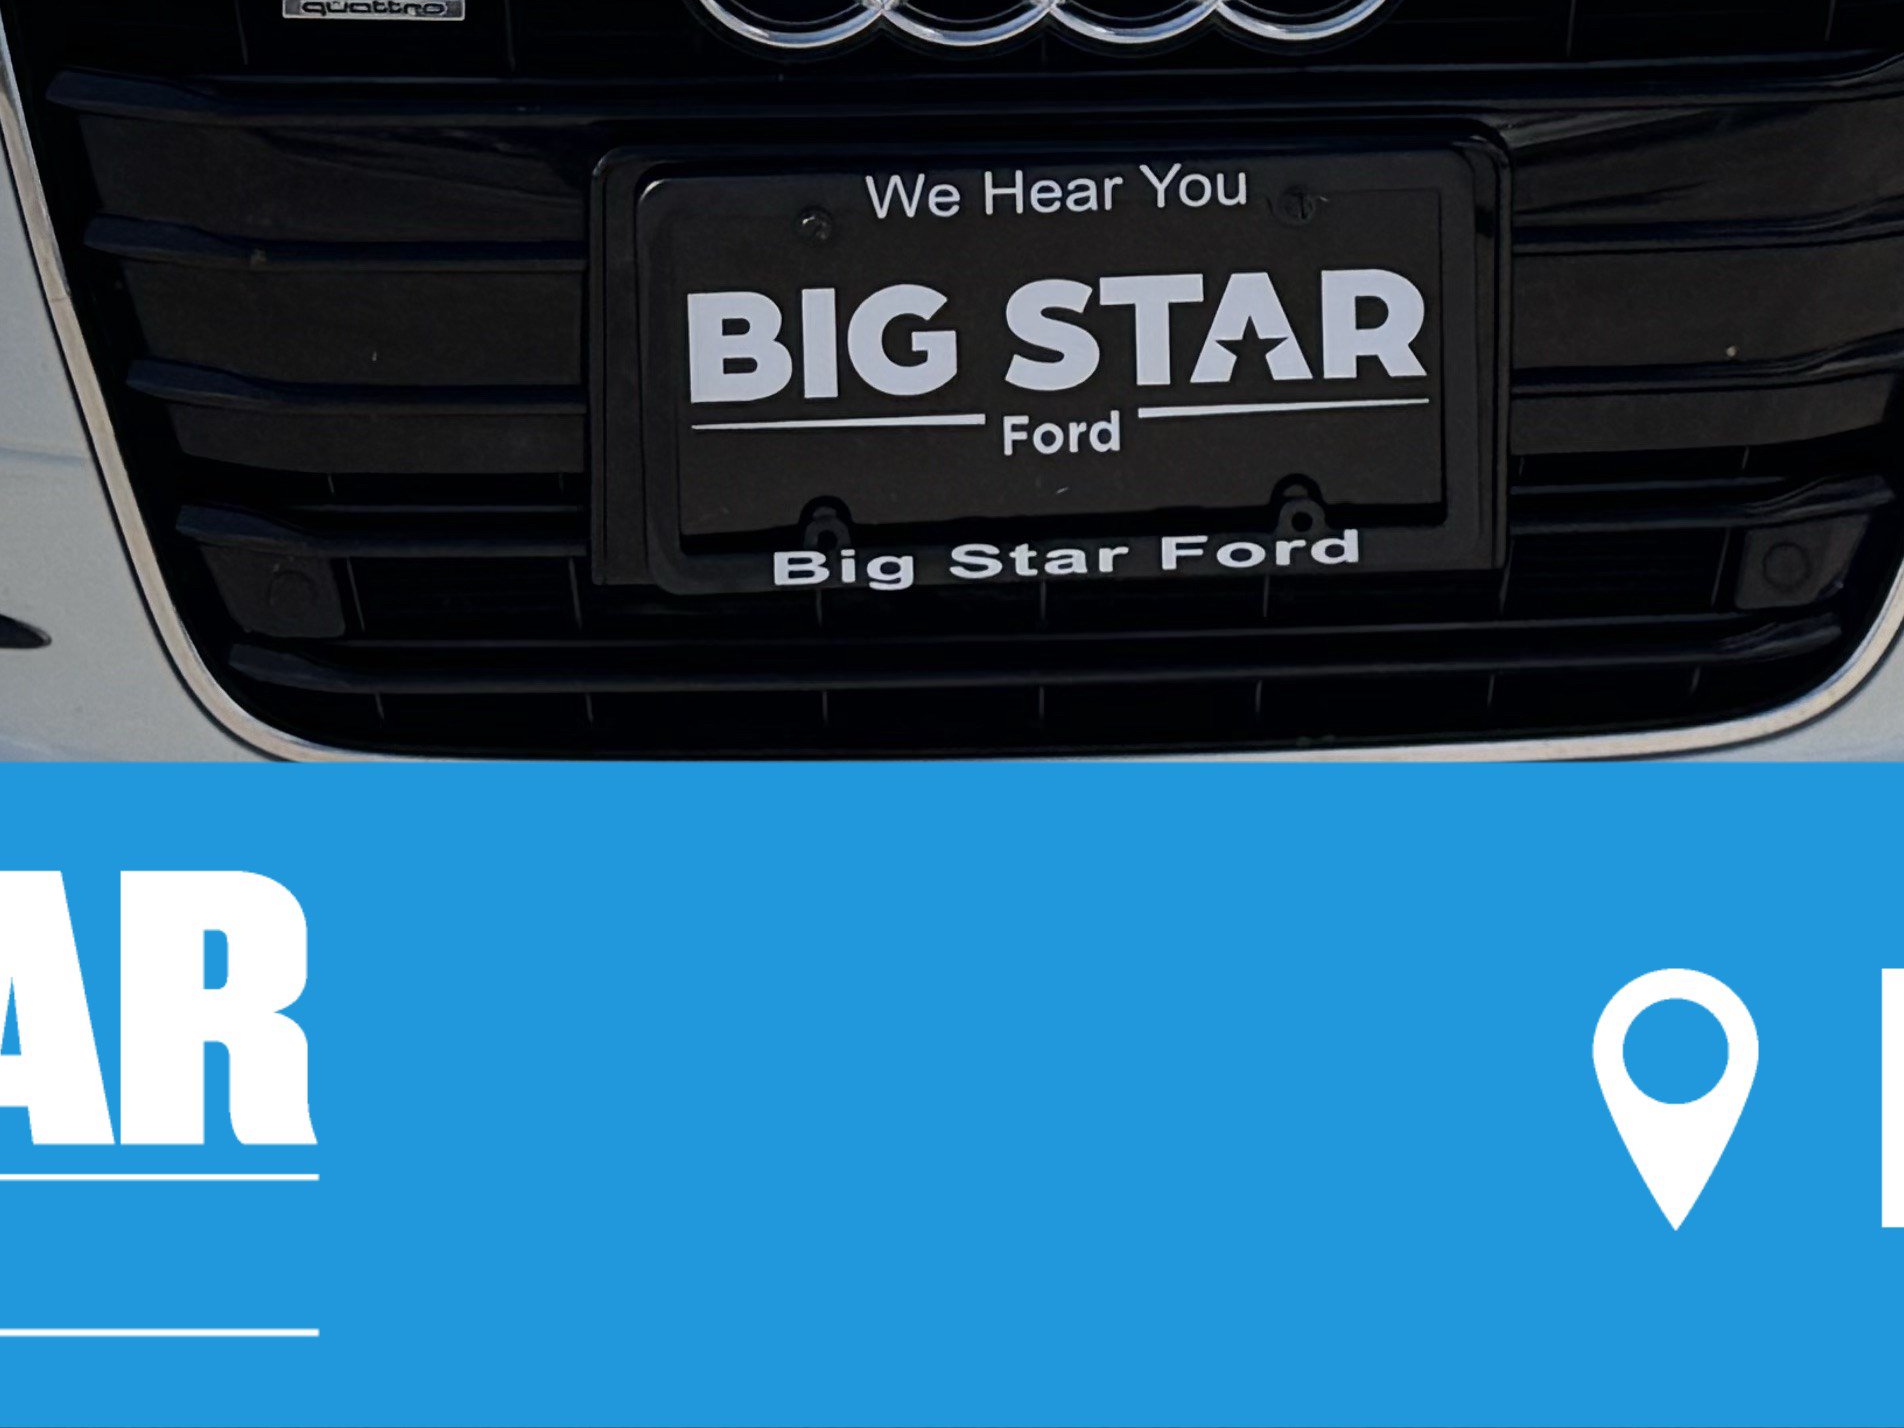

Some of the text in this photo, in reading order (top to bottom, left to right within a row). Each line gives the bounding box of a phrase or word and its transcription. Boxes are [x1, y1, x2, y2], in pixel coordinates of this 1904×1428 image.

[298, 0, 449, 18] quattro
[865, 163, 1247, 219] We Hear You
[687, 268, 1427, 404] BIG STAR
[1003, 409, 1121, 456] Ford
[773, 528, 1359, 591] Big Star Ford
